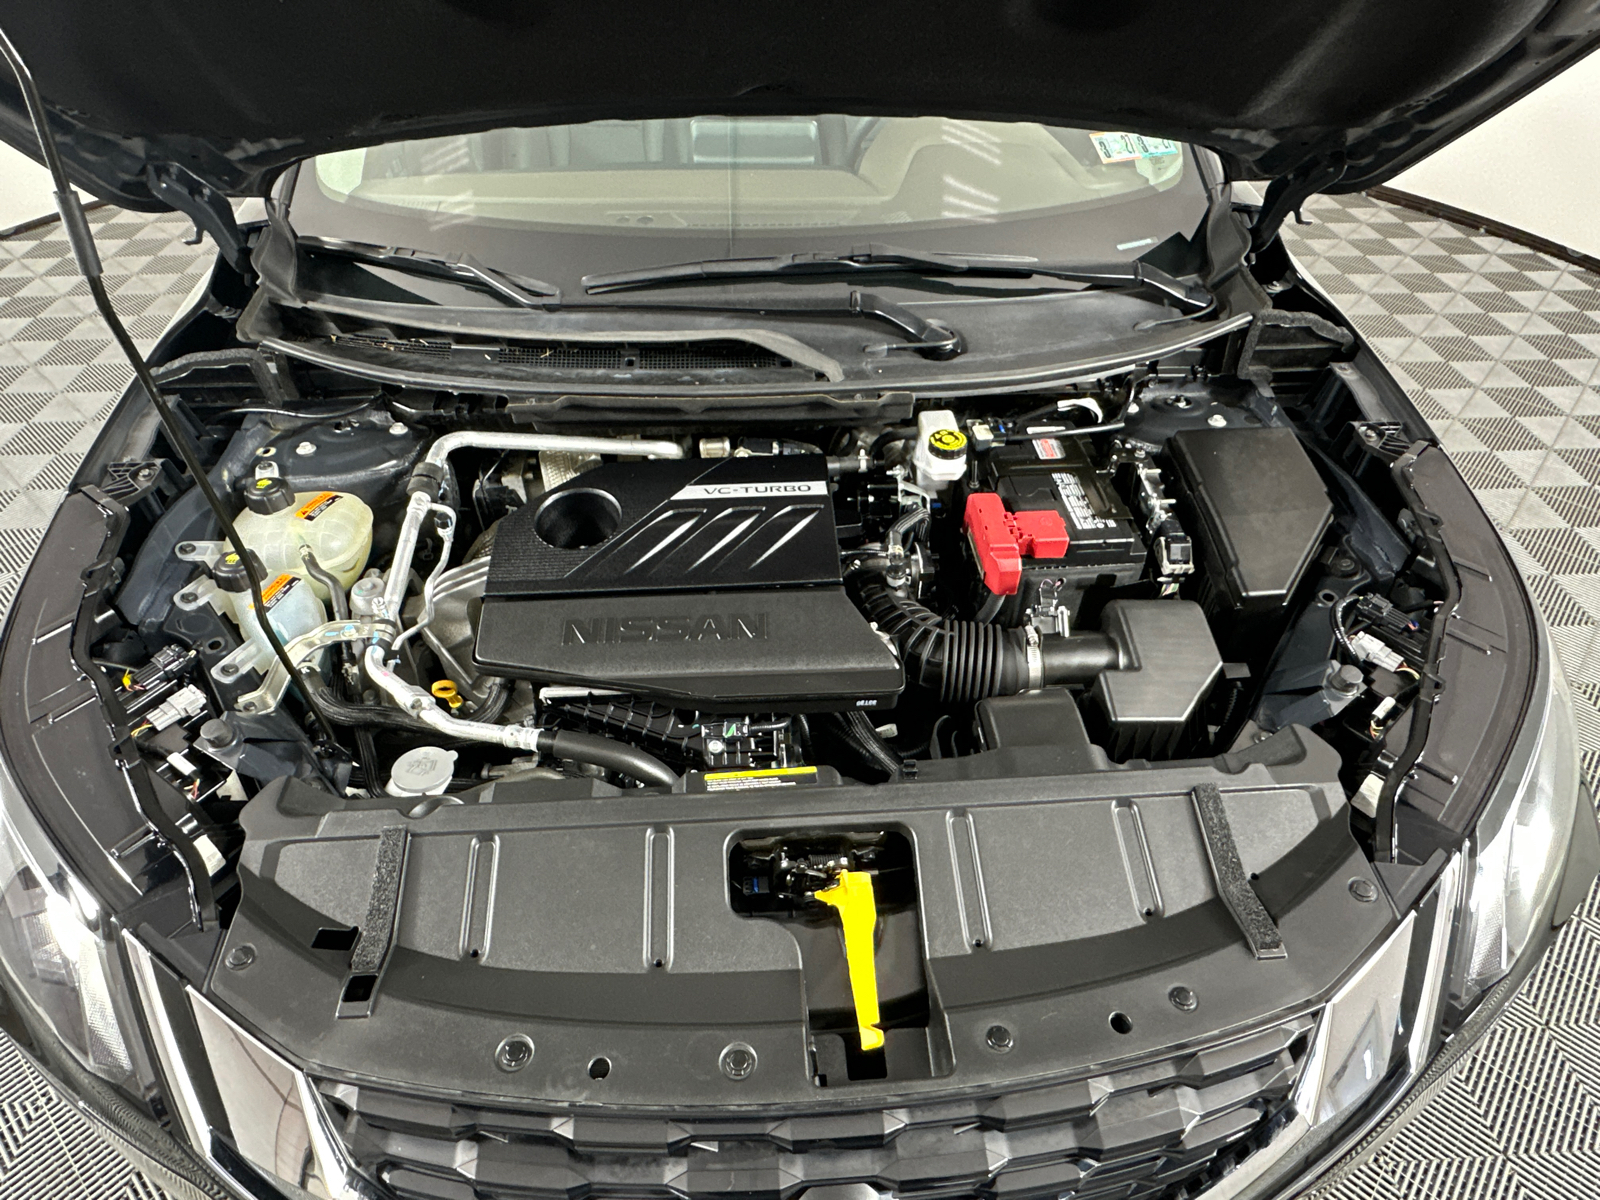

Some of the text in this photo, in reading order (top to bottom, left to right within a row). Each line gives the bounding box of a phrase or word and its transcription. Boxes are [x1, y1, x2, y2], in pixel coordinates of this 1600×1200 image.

[1099, 141, 1111, 158] 3
[1137, 136, 1149, 153] 3
[703, 484, 811, 495] VC-TURBO
[561, 613, 768, 645] NISSAN
